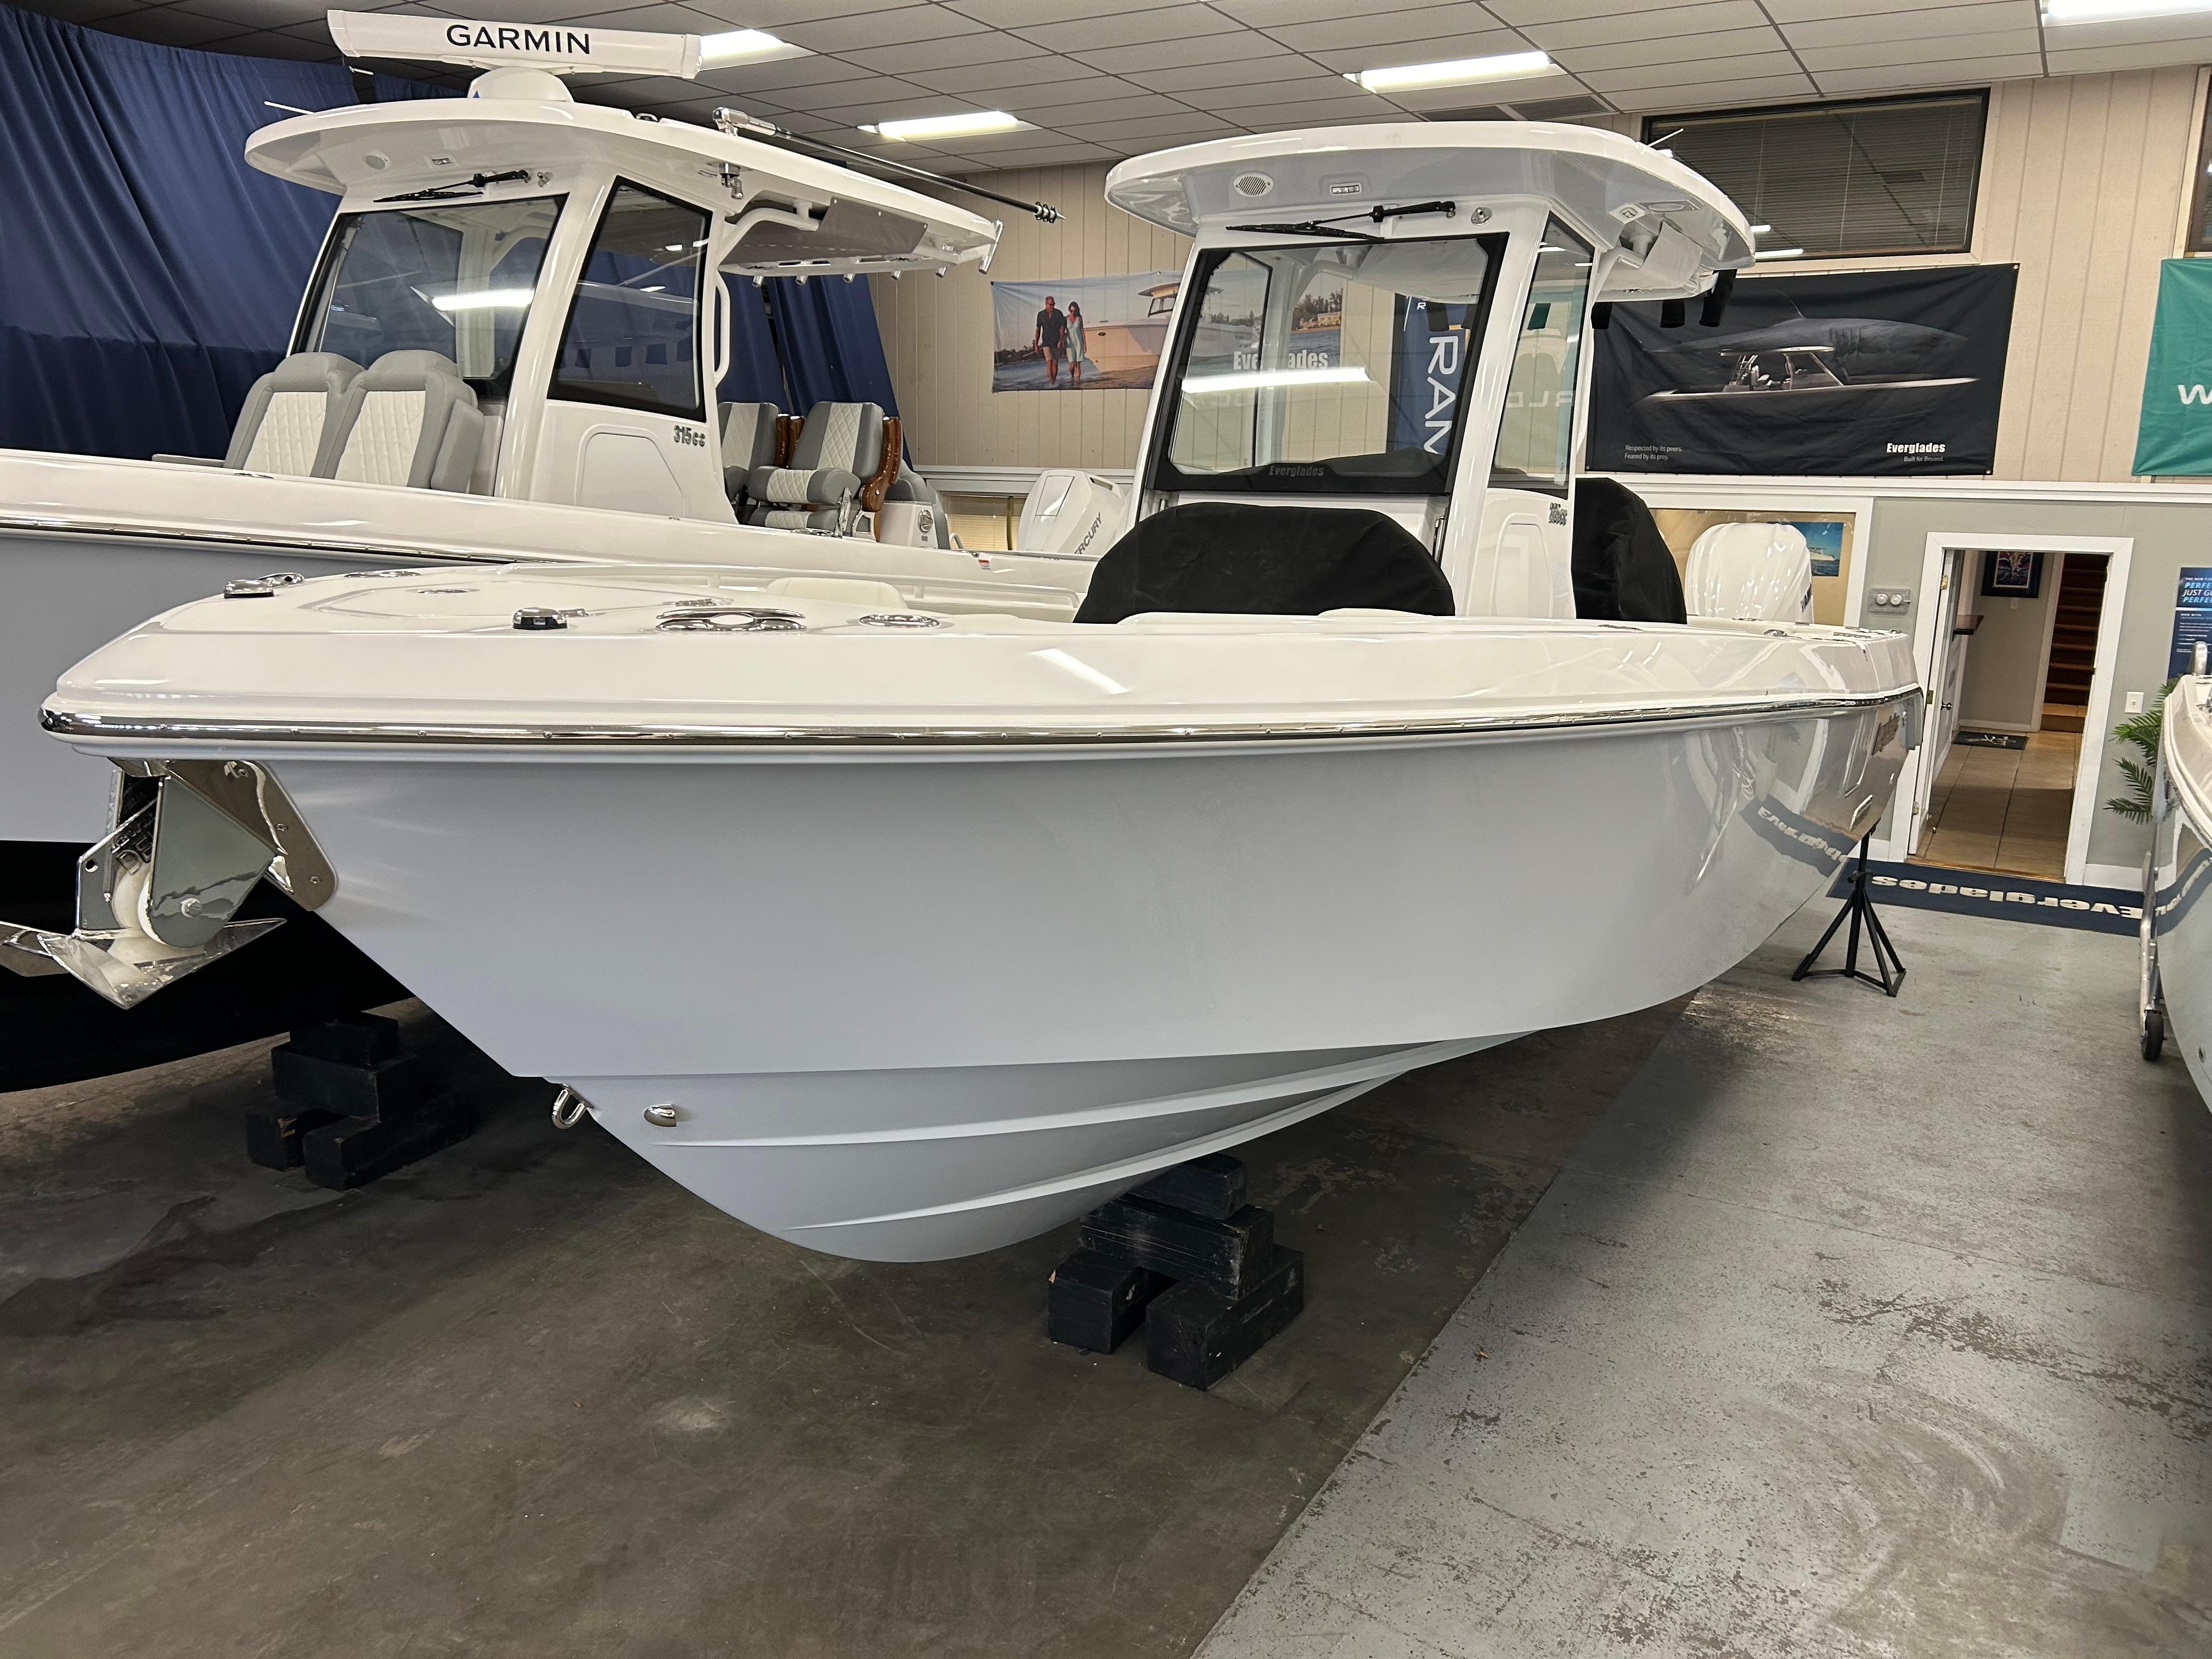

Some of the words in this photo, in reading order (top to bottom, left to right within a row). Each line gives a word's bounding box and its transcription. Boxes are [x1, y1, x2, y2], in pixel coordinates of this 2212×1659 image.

[446, 24, 590, 55] GARMIN
[1233, 349, 1329, 370] Eveades
[1886, 442, 1946, 454] Everglades
[1643, 453, 1649, 461] by
[1269, 465, 1324, 477] Everglades
[1871, 876, 2143, 919] Everglades
